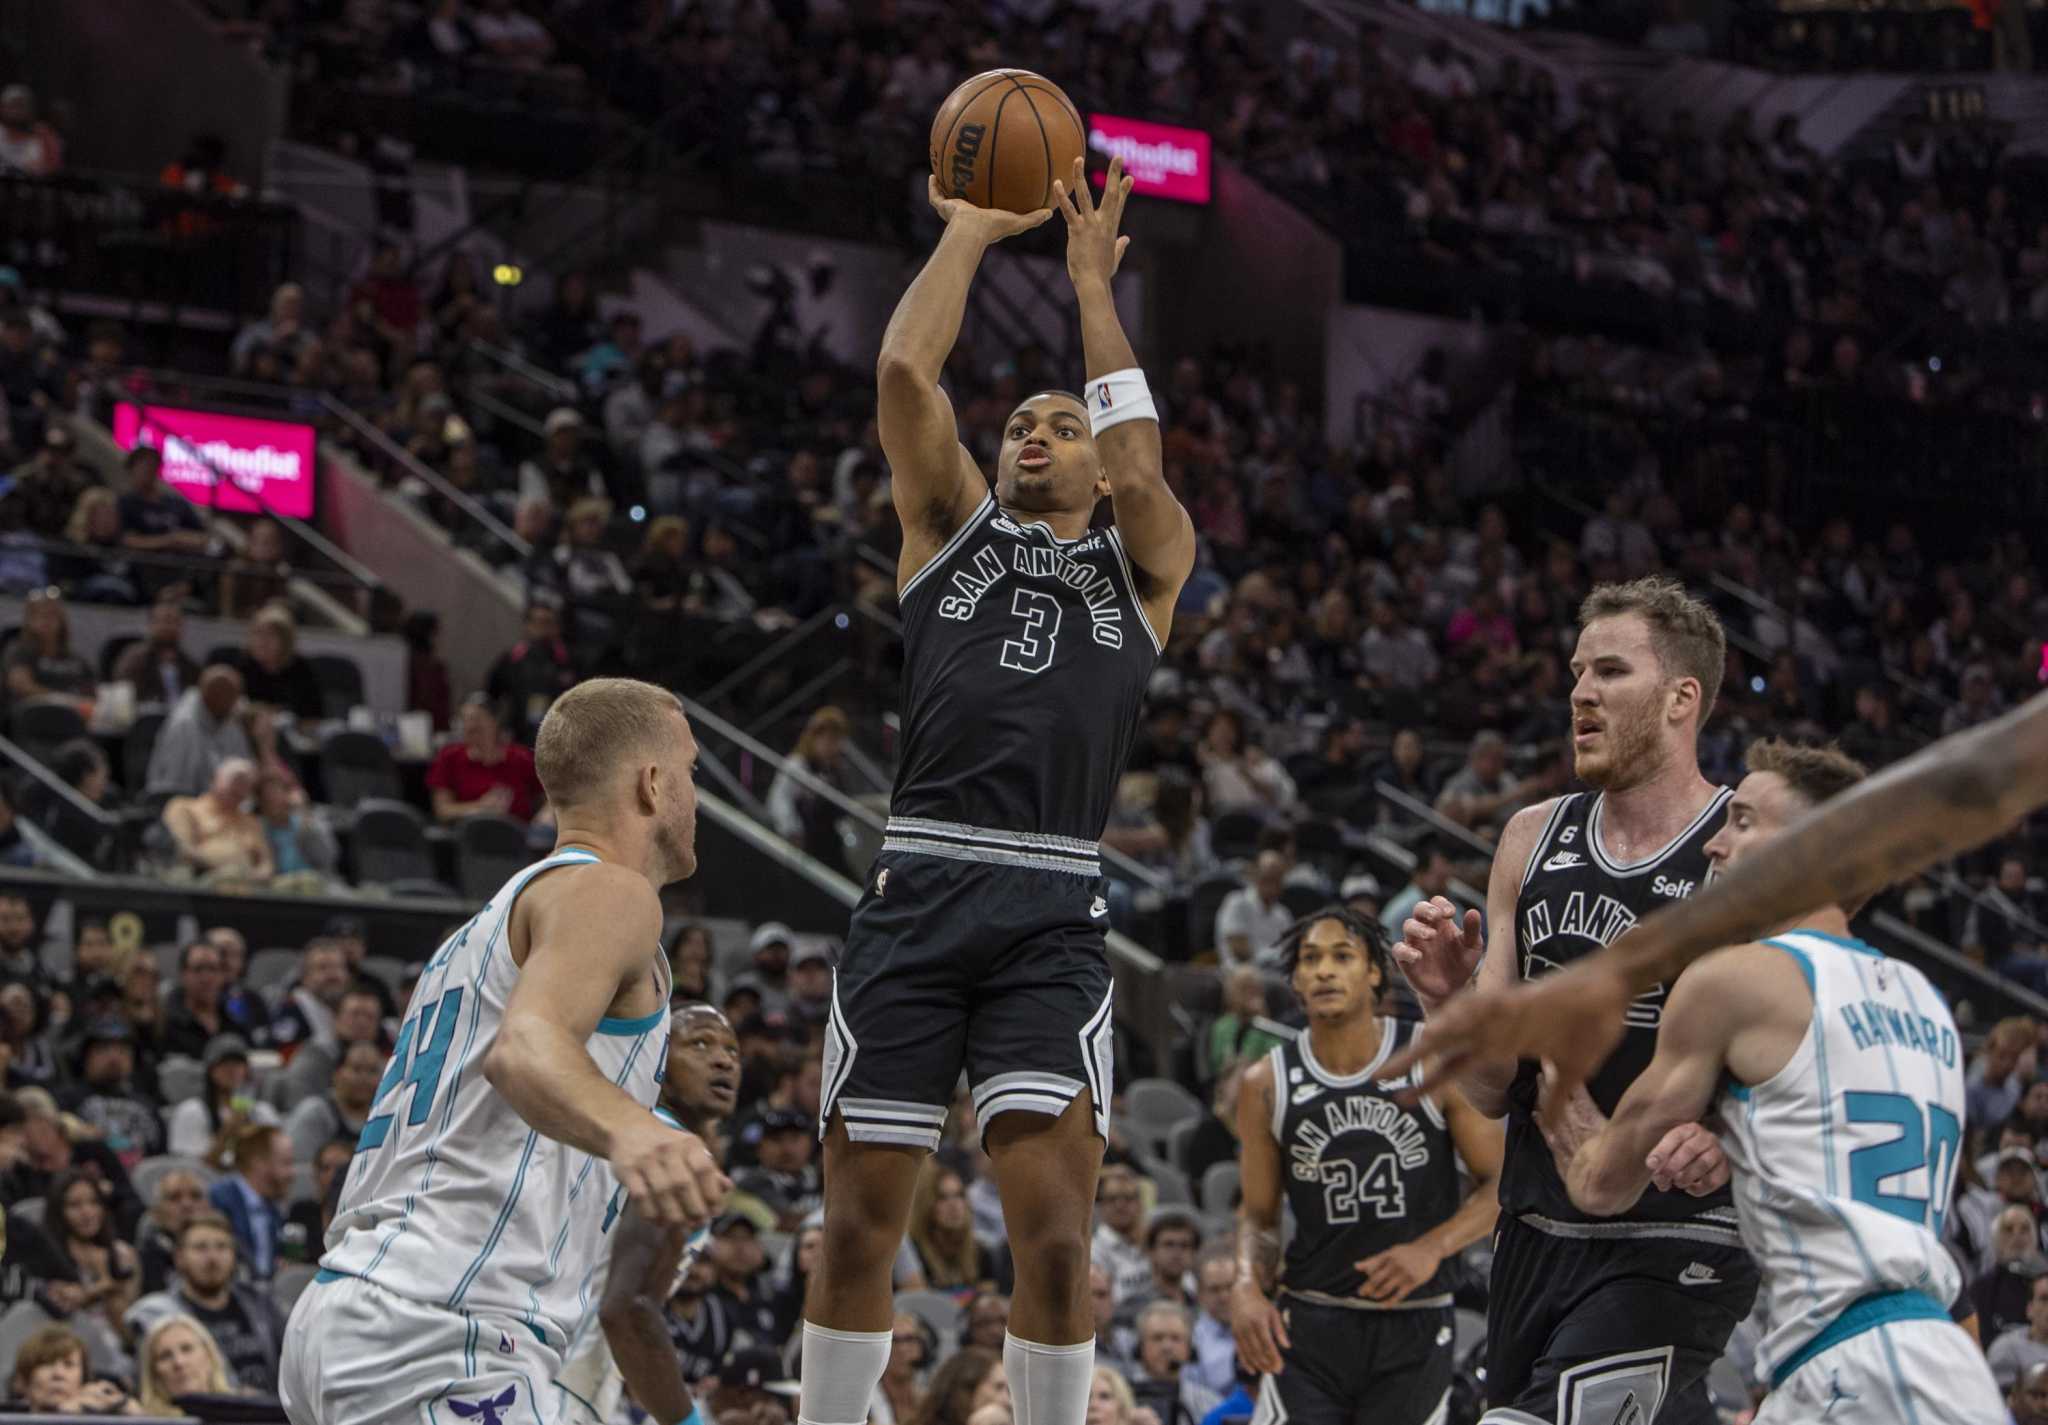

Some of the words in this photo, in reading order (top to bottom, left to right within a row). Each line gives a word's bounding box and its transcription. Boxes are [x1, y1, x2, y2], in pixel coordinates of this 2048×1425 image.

[939, 544, 1006, 621] SAN
[1013, 543, 1122, 650] ANTONIO
[1000, 588, 1063, 674] 3
[1551, 850, 1581, 864] NIKE
[1558, 826, 1578, 844] 6
[356, 986, 464, 1153] 24
[1841, 1001, 1955, 1070] HAYWARD
[1290, 1119, 1331, 1182] SAN
[1324, 1096, 1429, 1170] ANTONIO
[1844, 1091, 1960, 1242] 20
[1319, 1153, 1406, 1224] 24
[1688, 1261, 1715, 1278] NIKE
